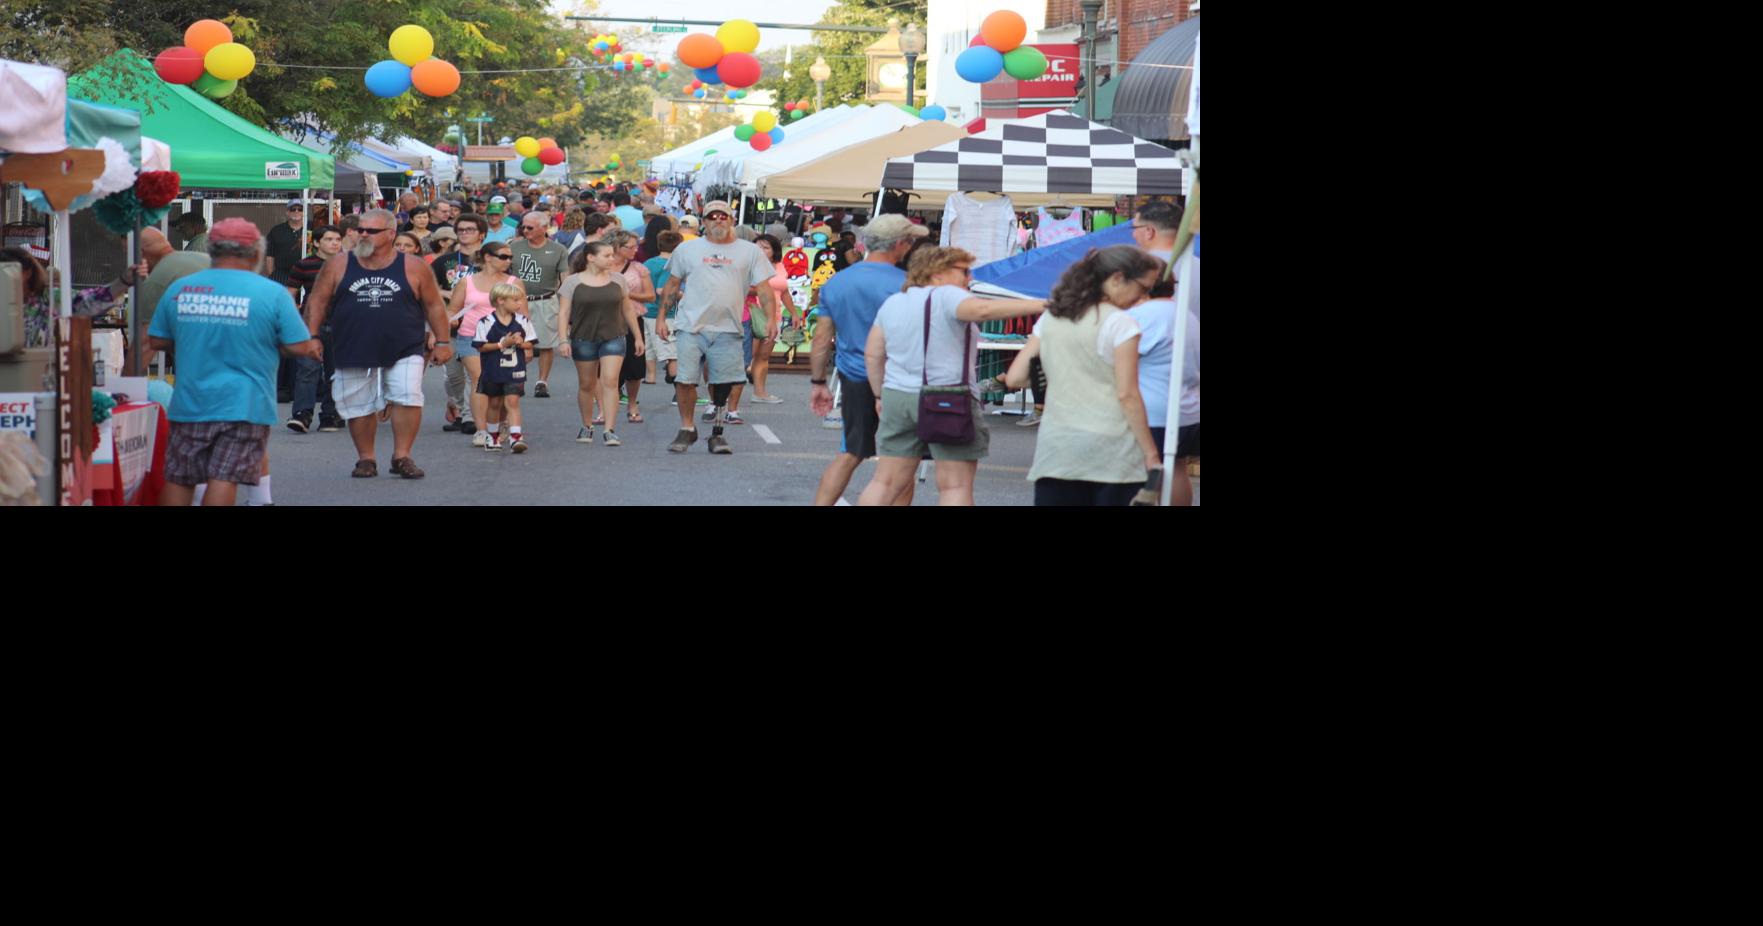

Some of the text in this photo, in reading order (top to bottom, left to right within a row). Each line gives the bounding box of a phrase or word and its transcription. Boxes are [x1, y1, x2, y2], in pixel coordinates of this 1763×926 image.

[370, 276, 385, 285] CITY
[178, 294, 250, 307] STEPHANIE
[177, 303, 248, 318] NORMAN
